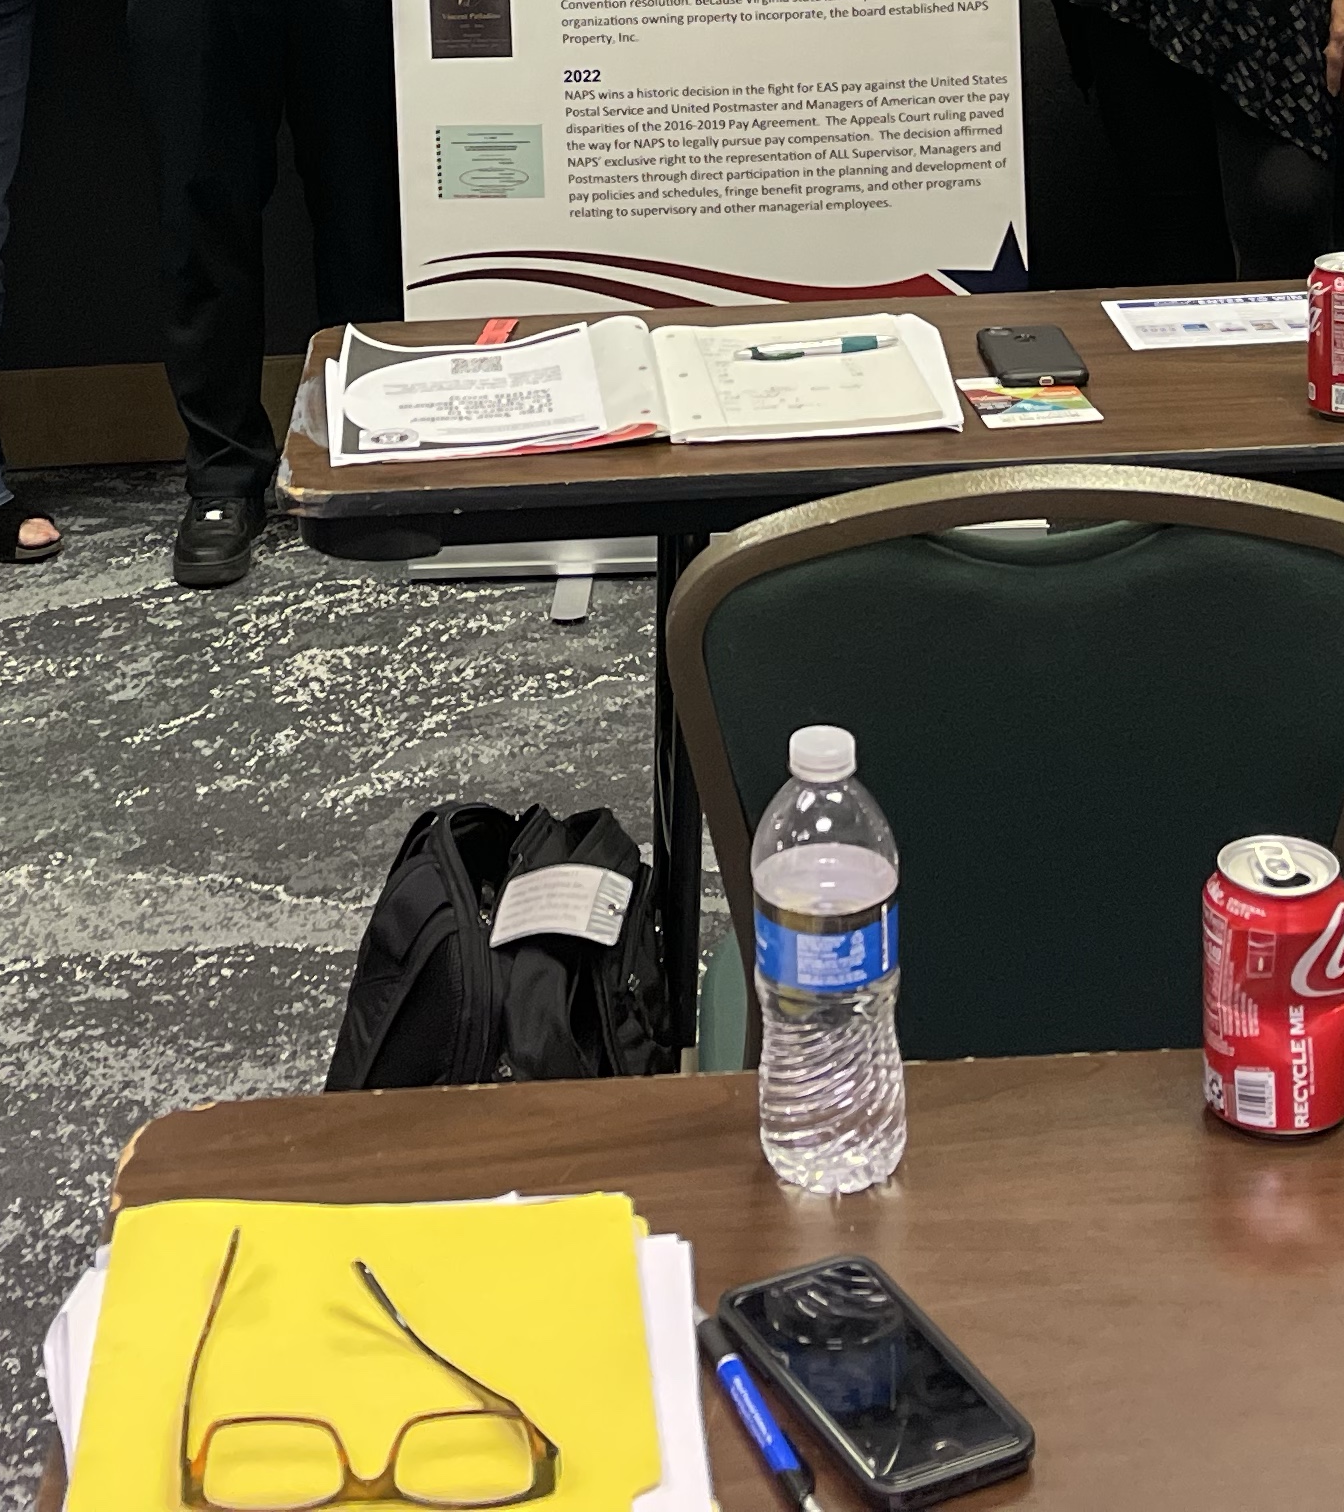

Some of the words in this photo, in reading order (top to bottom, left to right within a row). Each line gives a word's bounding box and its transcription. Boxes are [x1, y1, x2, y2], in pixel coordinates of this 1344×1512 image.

[560, 15, 639, 29] organizations
[640, 14, 685, 26] owning
[686, 12, 738, 25] property
[739, 11, 753, 22] to
[828, 6, 849, 18] the
[851, 4, 886, 17] board
[887, 1, 955, 16] established
[956, 0, 989, 12] NAPS
[563, 68, 602, 83] 2022
[564, 105, 600, 118] Postal
[601, 105, 645, 117] Service
[646, 103, 669, 115] and
[670, 102, 710, 114] United
[712, 101, 779, 113] Postmaster
[780, 99, 803, 111] and
[805, 98, 864, 111] Managers
[865, 95, 878, 108] of
[879, 95, 936, 107] American
[937, 94, 964, 104] over
[966, 91, 986, 103] the
[988, 92, 1010, 104] pay
[567, 173, 639, 184] Postmasters
[640, 170, 688, 184] through
[689, 169, 724, 181] direct
[725, 167, 800, 182] participation
[802, 168, 814, 177] in
[815, 165, 836, 177] the
[837, 164, 889, 178] planning
[890, 161, 913, 174] and
[914, 159, 992, 173] development
[994, 156, 1007, 169] of
[1289, 1004, 1306, 1036] ME
[1290, 1037, 1310, 1128] RECYCLE
